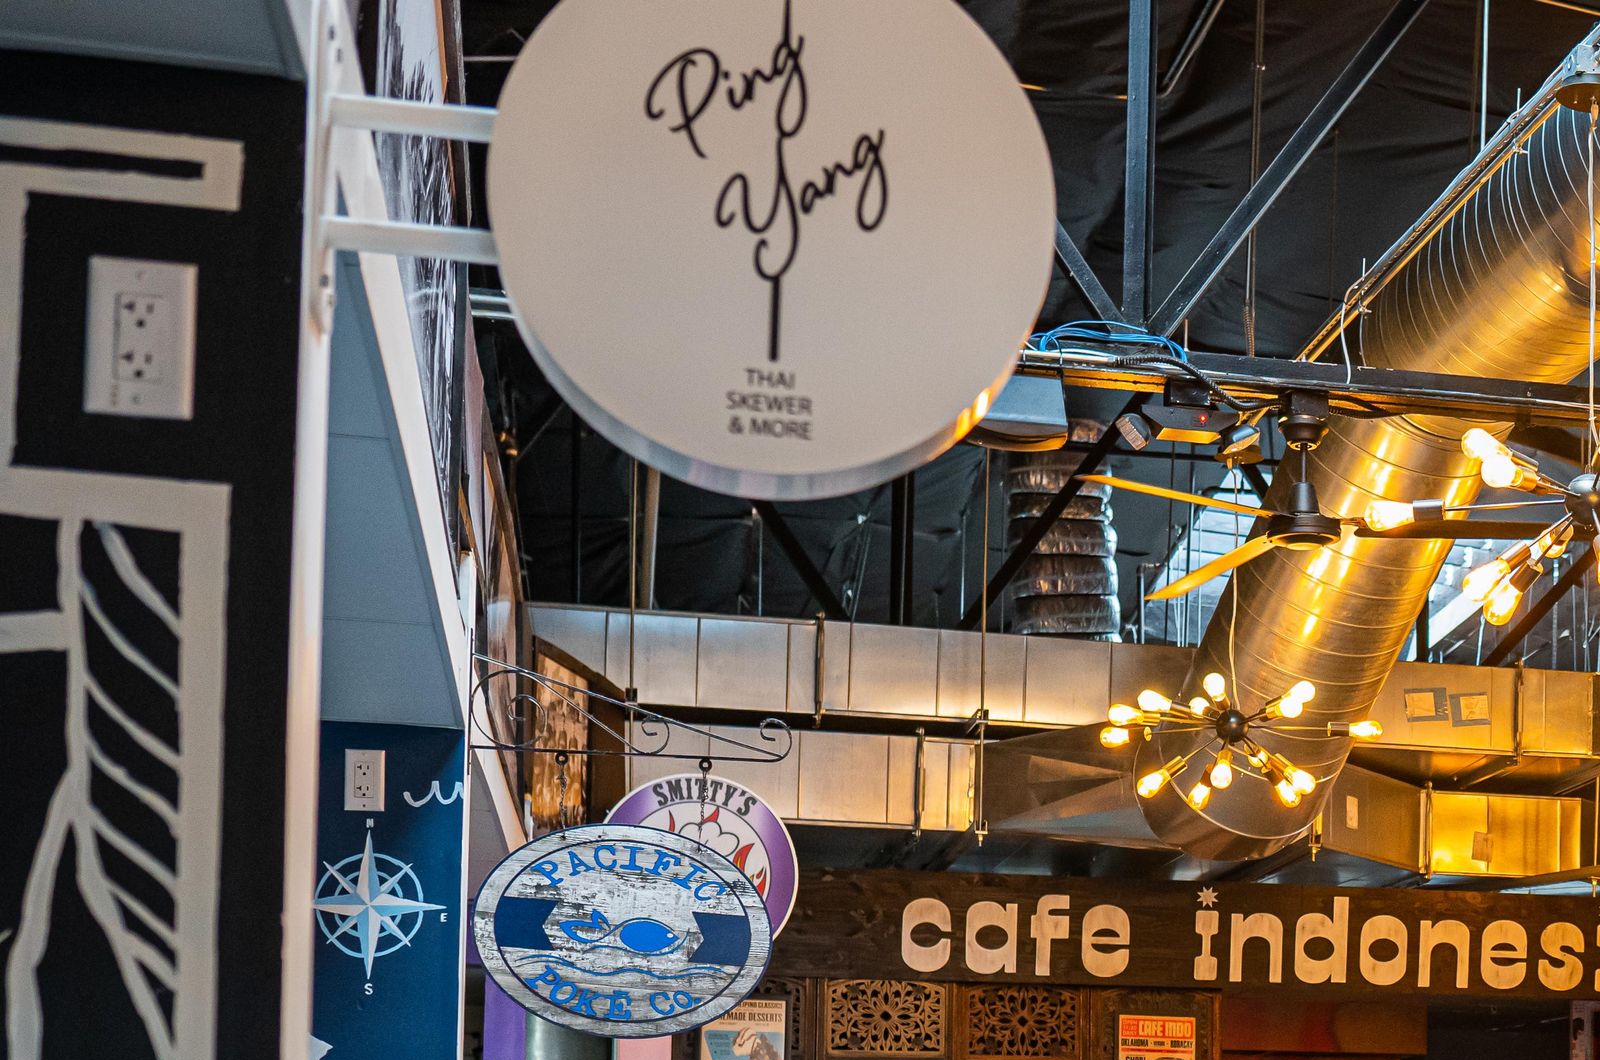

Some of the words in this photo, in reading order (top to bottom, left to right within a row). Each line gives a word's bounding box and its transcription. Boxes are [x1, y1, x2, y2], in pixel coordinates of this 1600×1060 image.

[646, 35, 807, 158] Ping
[716, 129, 888, 281] Yang
[745, 369, 796, 389] THAI
[726, 391, 813, 415] SKEWER
[728, 417, 744, 436] &
[749, 417, 813, 440] MORE
[652, 775, 758, 817] SMITTY'S
[366, 818, 375, 829] N
[531, 844, 729, 903] PACIFIC
[440, 912, 447, 923] E
[900, 894, 1131, 978] cafe
[364, 983, 373, 996] S
[748, 1012, 783, 1022] DESSERTS
[1138, 1020, 1163, 1036] CAFE
